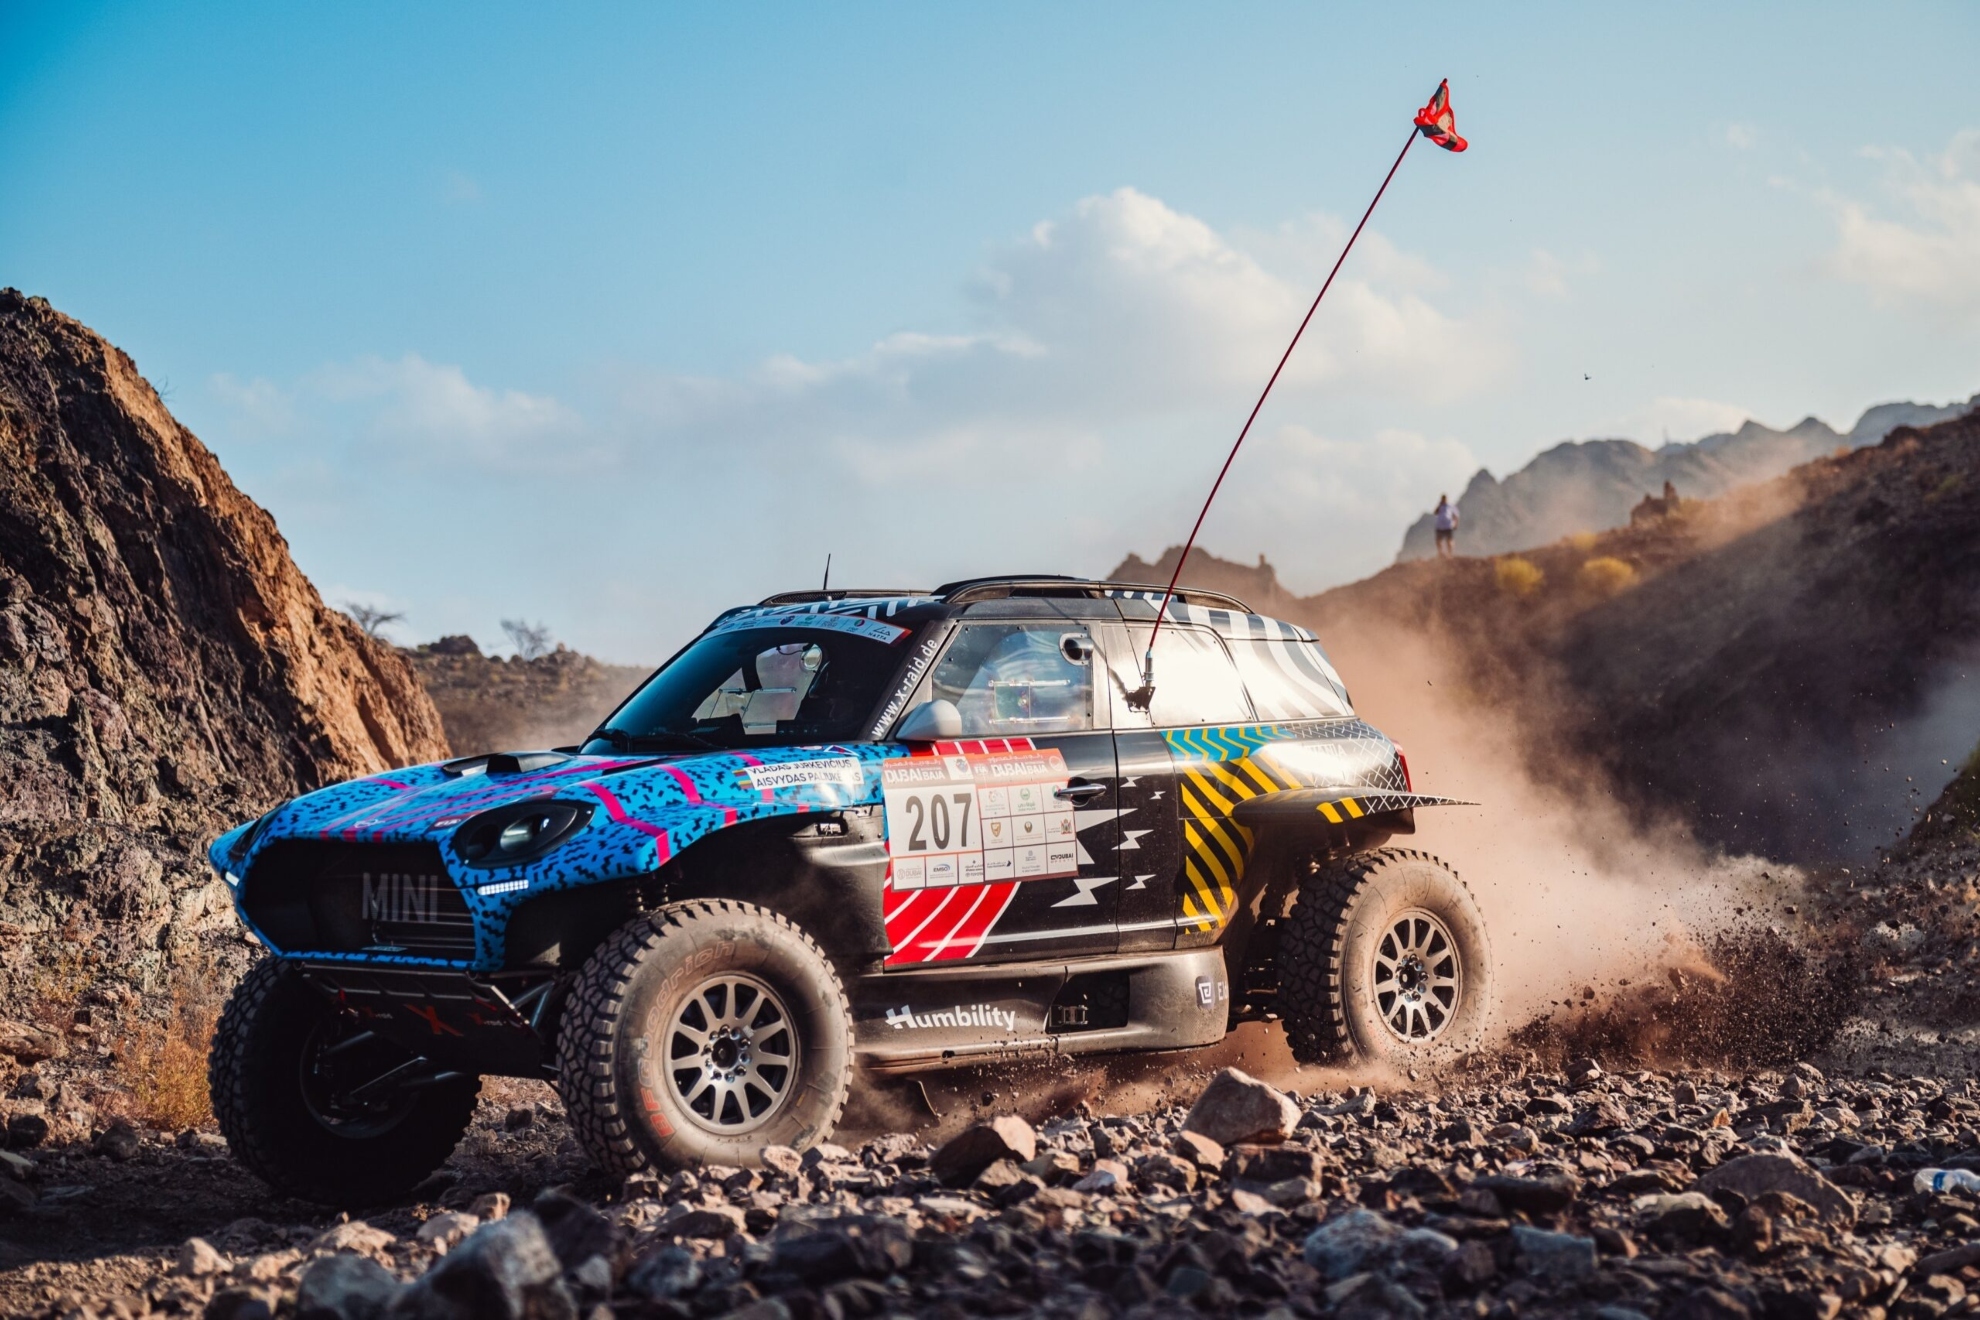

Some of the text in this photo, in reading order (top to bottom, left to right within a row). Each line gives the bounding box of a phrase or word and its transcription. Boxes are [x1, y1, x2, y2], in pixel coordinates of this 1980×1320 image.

[872, 639, 938, 737] www.x-raid.de
[748, 764, 792, 774] VLADAS
[884, 768, 922, 783] DUBAI
[990, 762, 1027, 777] DUBAI
[756, 773, 807, 787] AISVYDAS
[905, 793, 972, 852] 207
[362, 872, 438, 923] MINI
[885, 1004, 1015, 1031] Humbility
